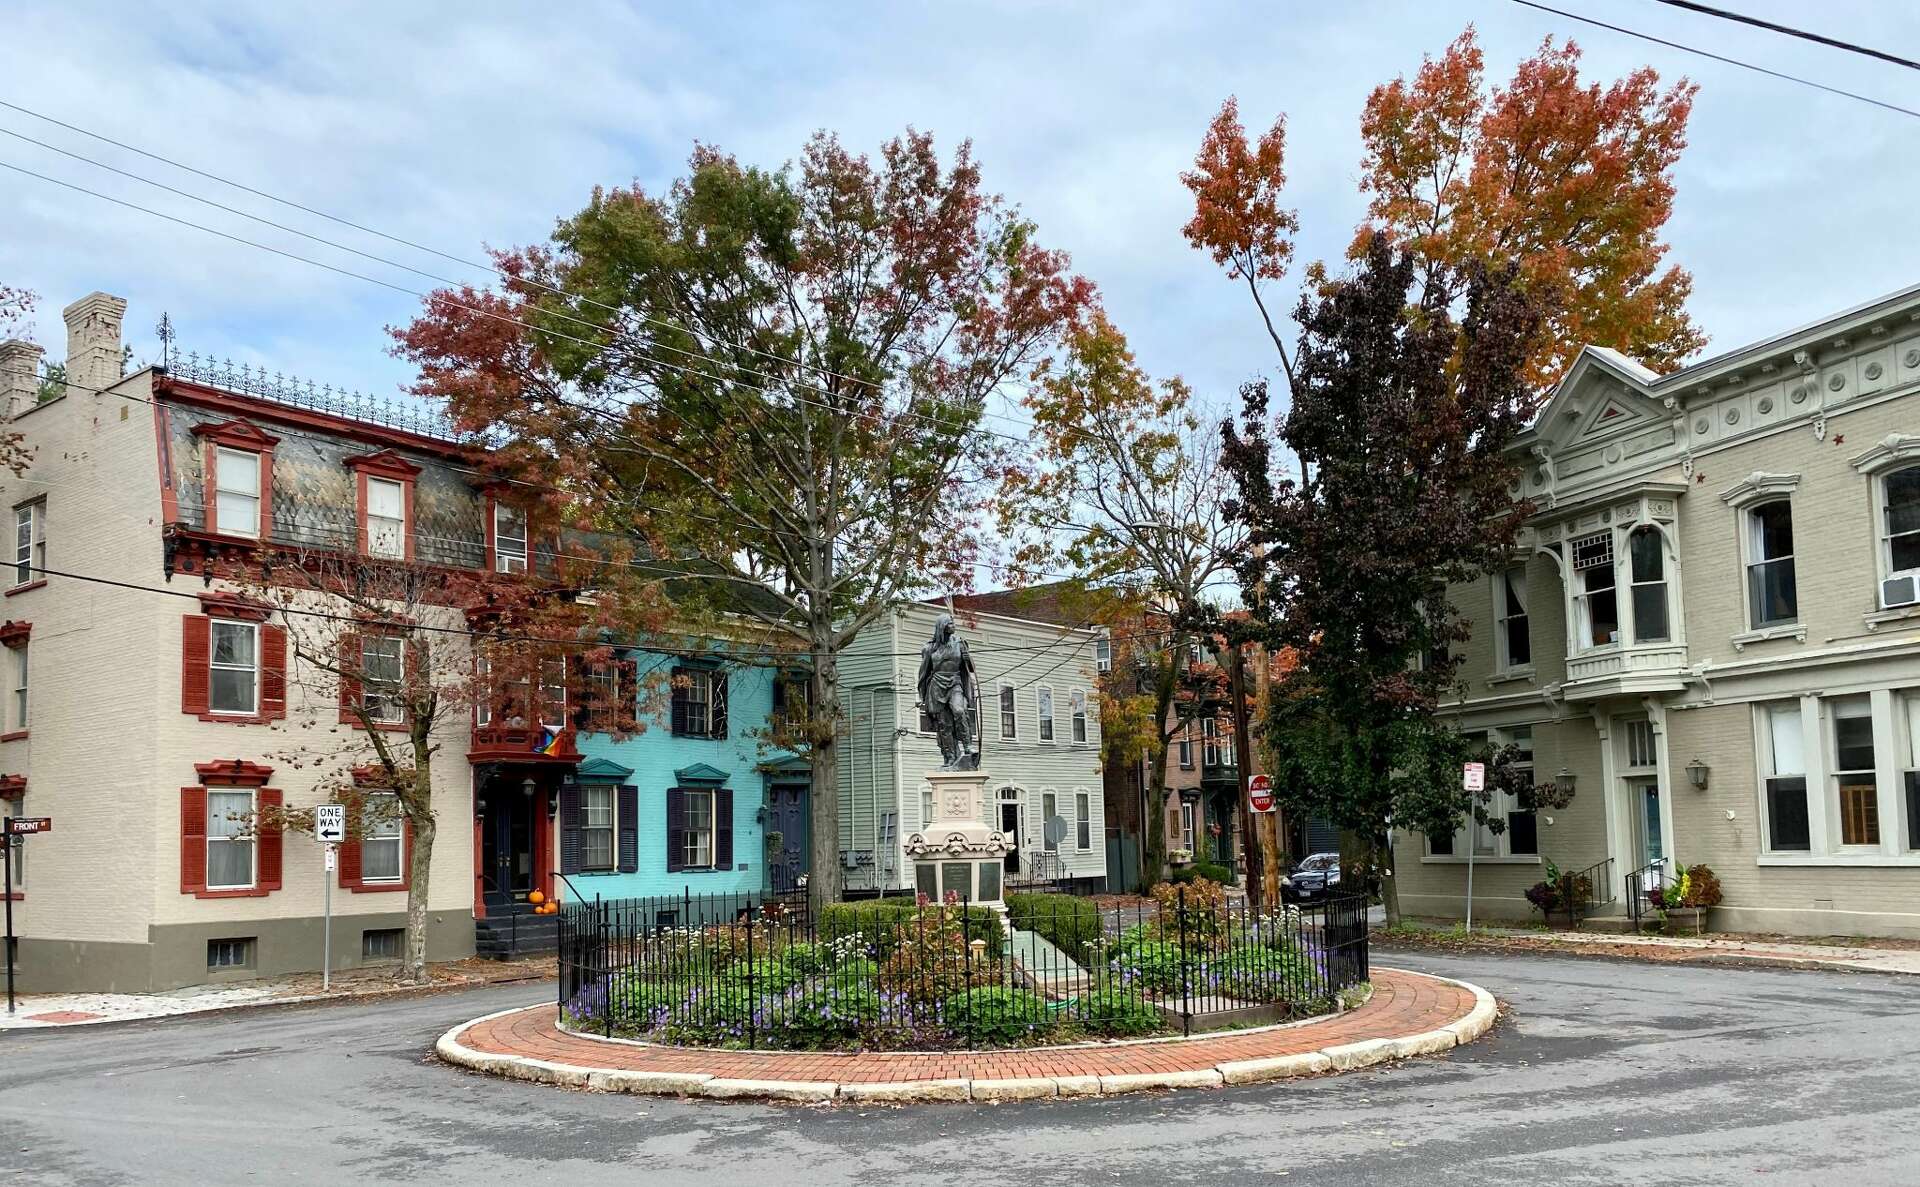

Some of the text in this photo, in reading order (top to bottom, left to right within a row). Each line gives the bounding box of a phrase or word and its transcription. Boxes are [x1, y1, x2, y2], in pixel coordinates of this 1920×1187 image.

[320, 808, 341, 817] ONE
[14, 822, 38, 830] FRONT
[320, 818, 341, 827] WAY
